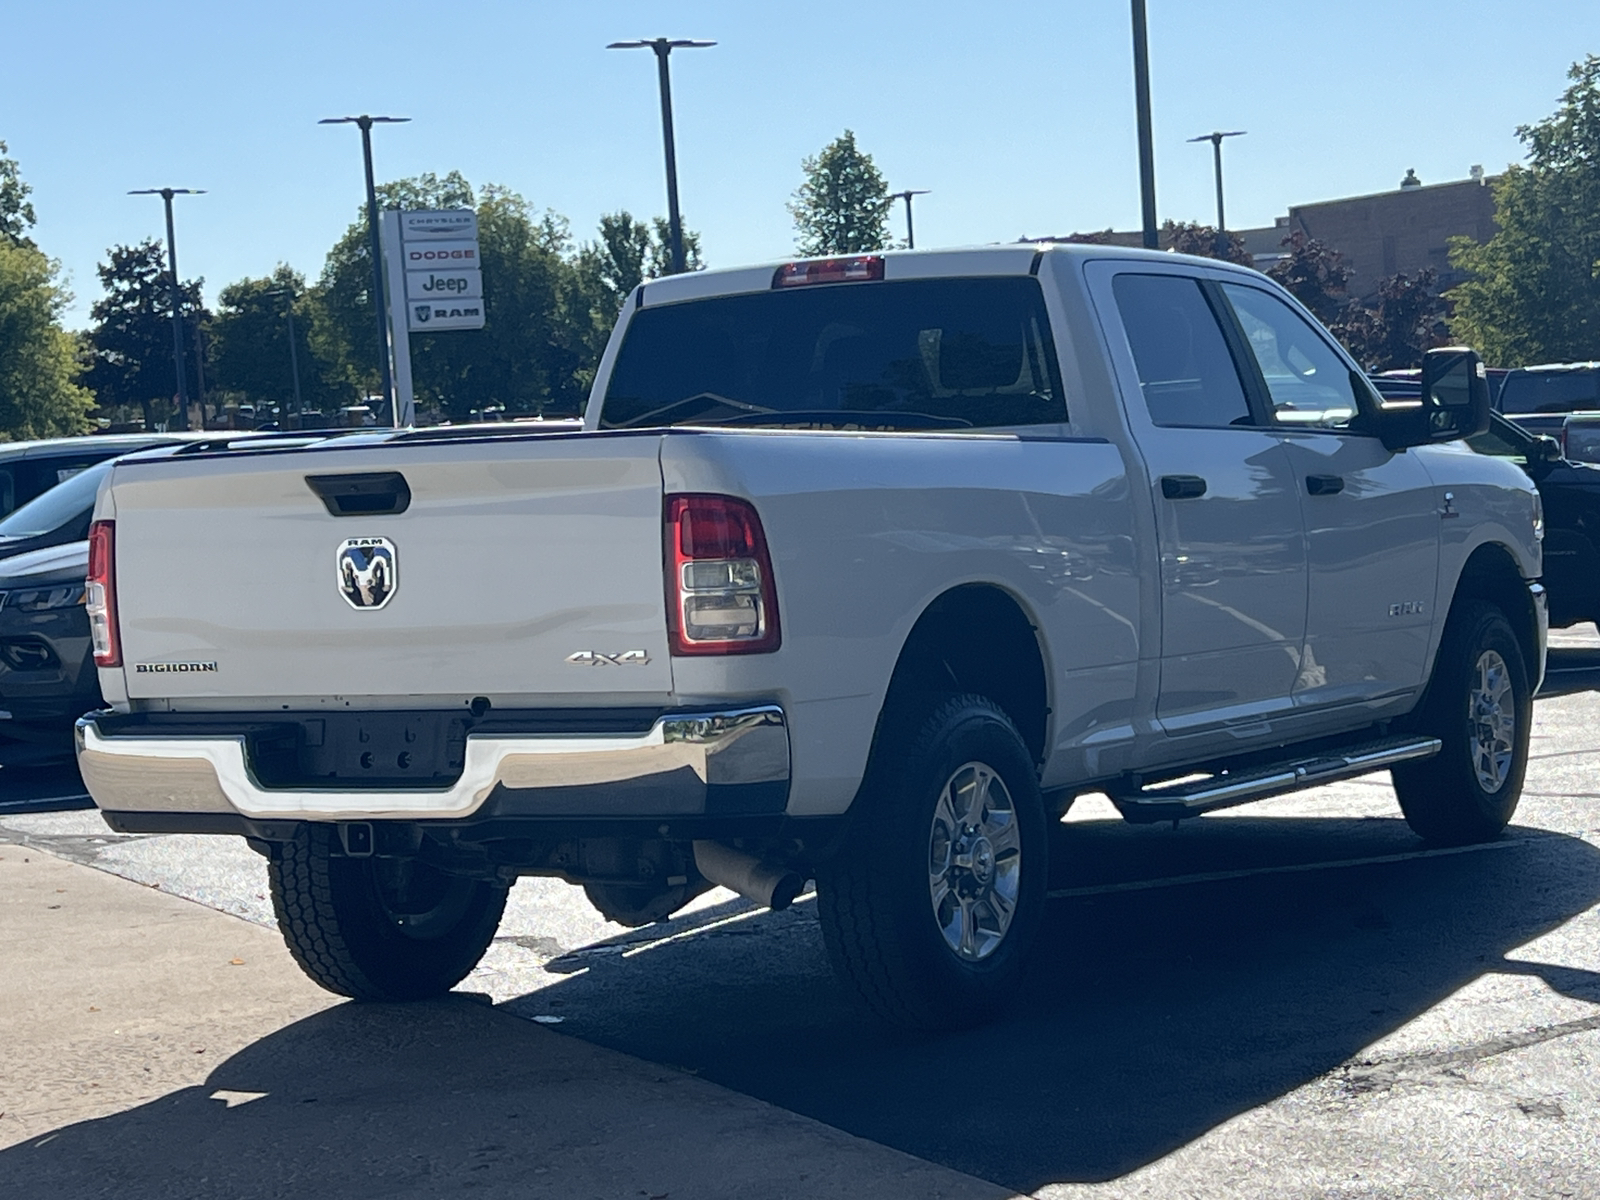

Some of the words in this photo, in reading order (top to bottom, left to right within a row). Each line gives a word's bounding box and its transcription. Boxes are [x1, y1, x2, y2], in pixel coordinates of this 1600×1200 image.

[408, 217, 472, 226] CHRYSLER
[409, 249, 476, 261] DODGE
[422, 274, 468, 294] Jeep
[434, 307, 480, 318] RAM
[347, 538, 383, 546] RAM
[1388, 601, 1424, 617] RAM
